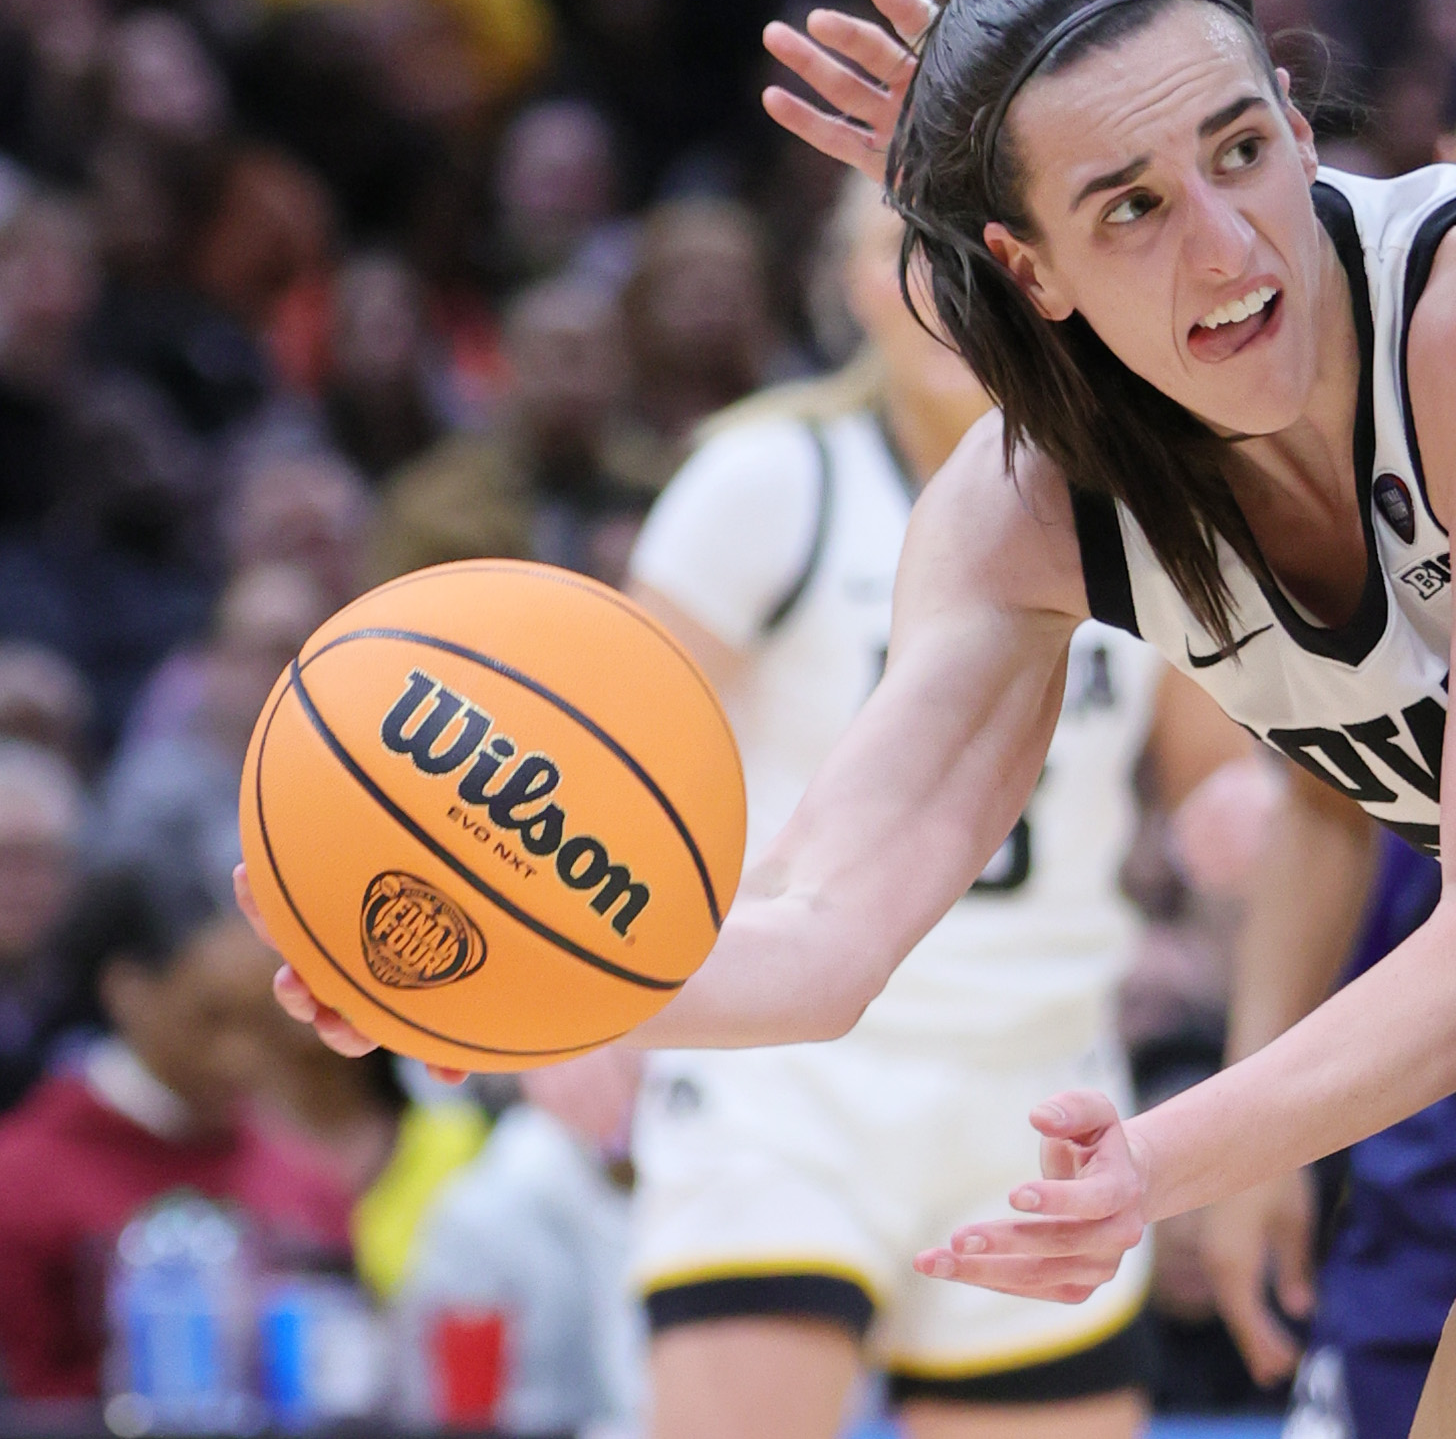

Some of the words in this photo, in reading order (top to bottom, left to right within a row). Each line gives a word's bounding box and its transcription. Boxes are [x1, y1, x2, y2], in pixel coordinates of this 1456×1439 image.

[379, 667, 652, 938] Wilson
[446, 805, 491, 843] EVO
[493, 841, 538, 879] NXT
[371, 914, 445, 978] FOUR
[389, 893, 459, 956] FINAL
